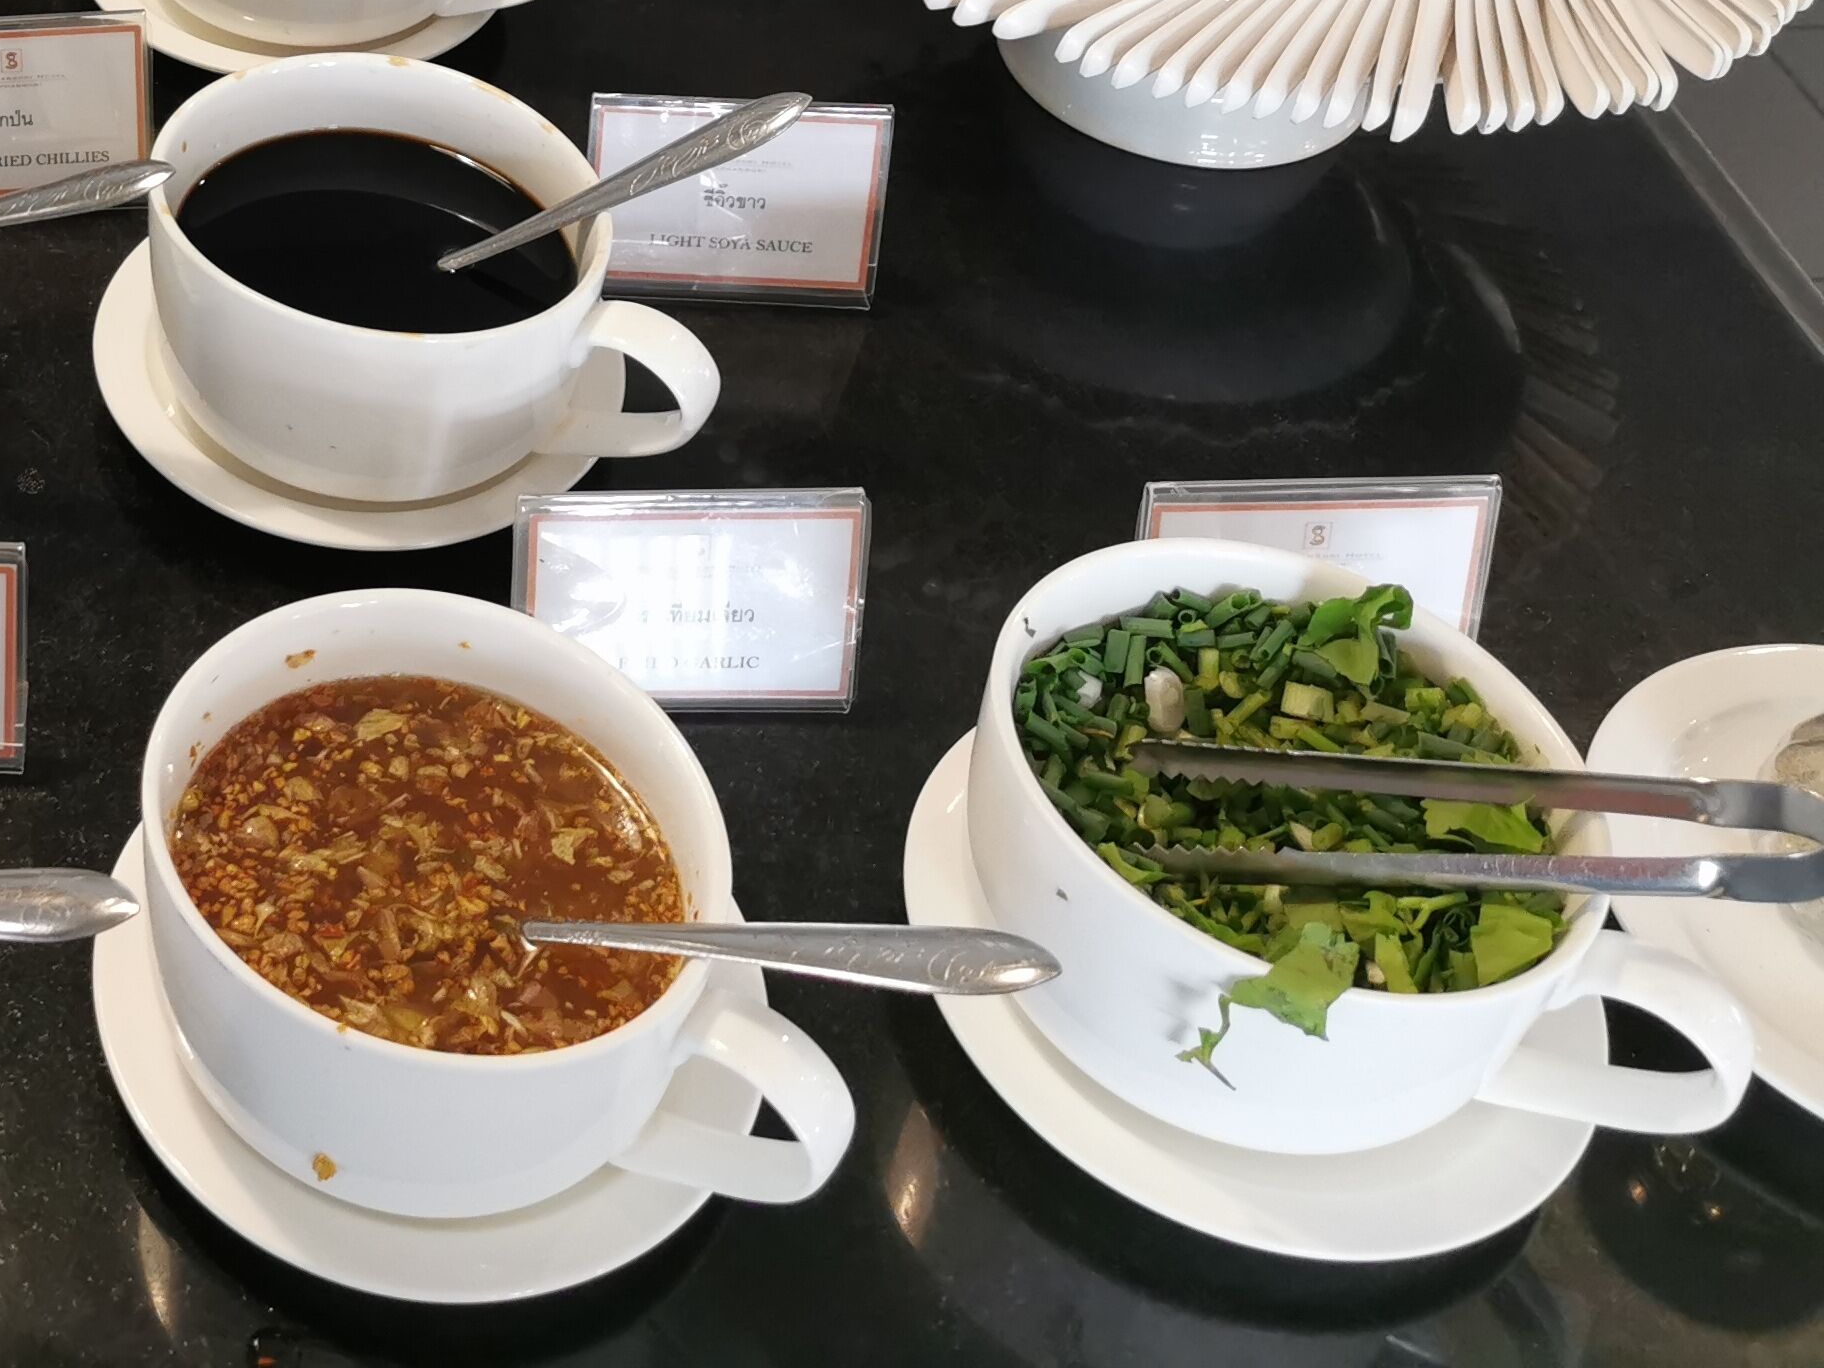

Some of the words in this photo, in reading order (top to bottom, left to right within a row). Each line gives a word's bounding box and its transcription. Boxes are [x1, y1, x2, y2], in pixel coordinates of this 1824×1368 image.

[36, 150, 111, 166] CHILLIES
[650, 234, 706, 248] LIGHT
[708, 236, 752, 251] SOYA
[755, 239, 814, 254] SAUCE
